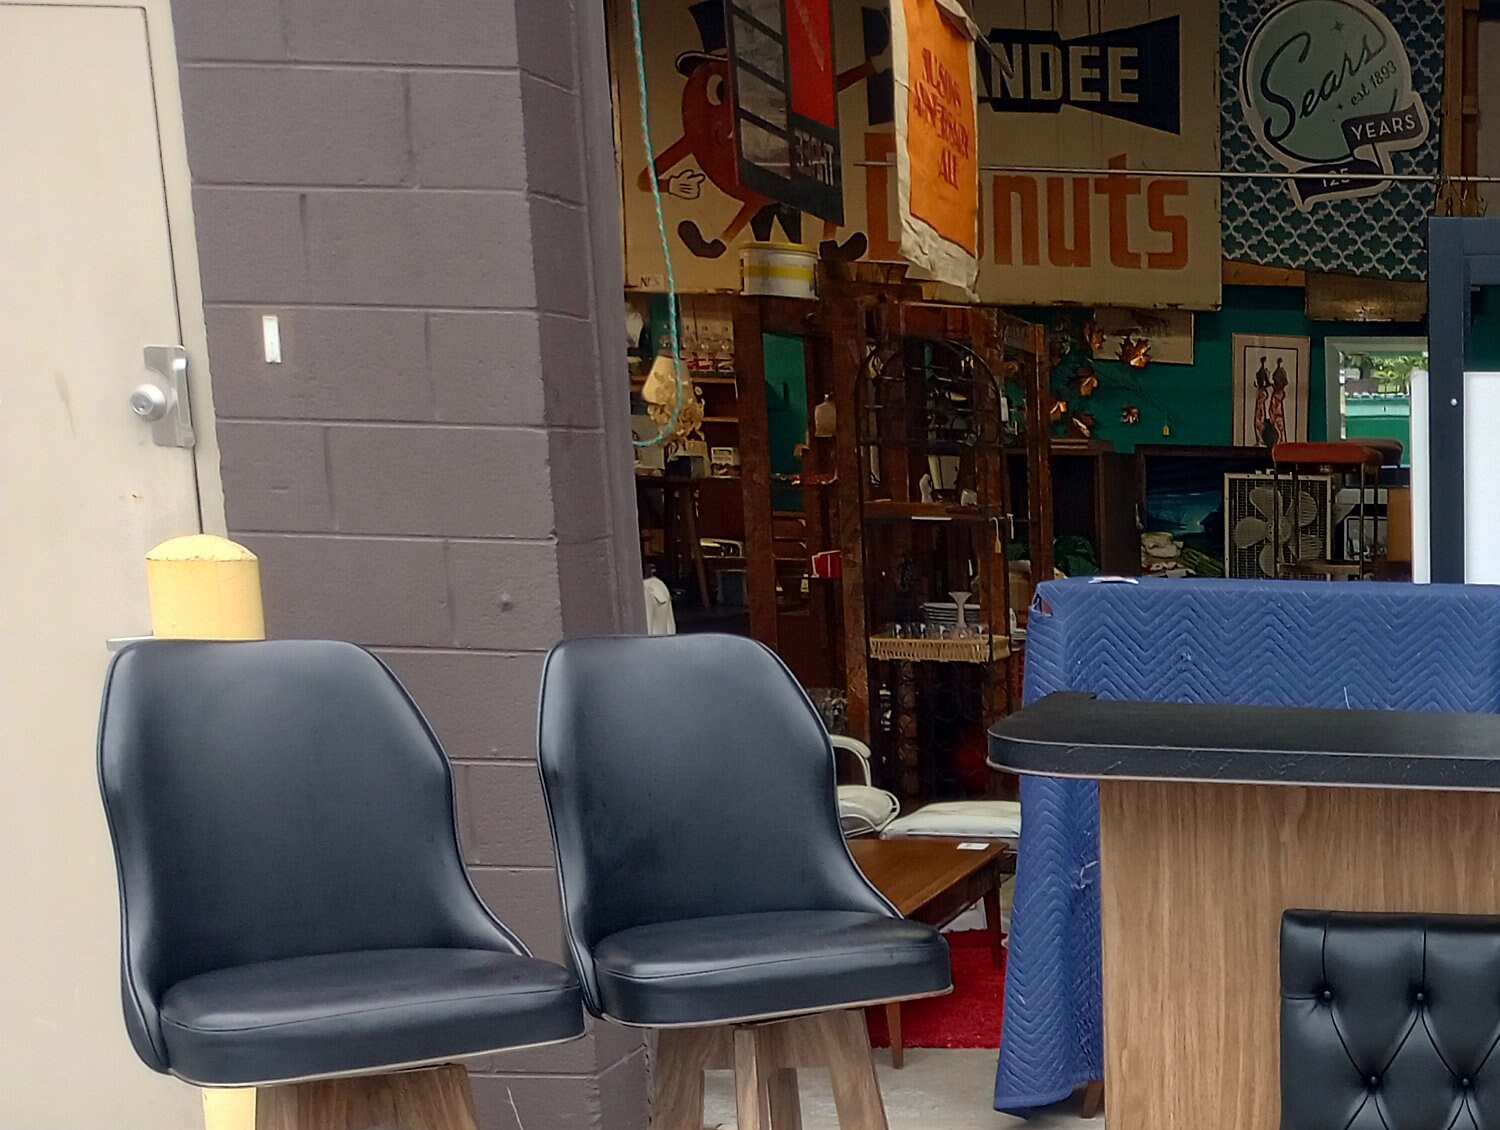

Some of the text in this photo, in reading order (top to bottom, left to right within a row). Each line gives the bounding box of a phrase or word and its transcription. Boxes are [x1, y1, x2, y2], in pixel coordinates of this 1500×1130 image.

[1260, 31, 1387, 142] Sears
[1350, 60, 1398, 106] est 1893
[1350, 114, 1417, 142] YEARS
